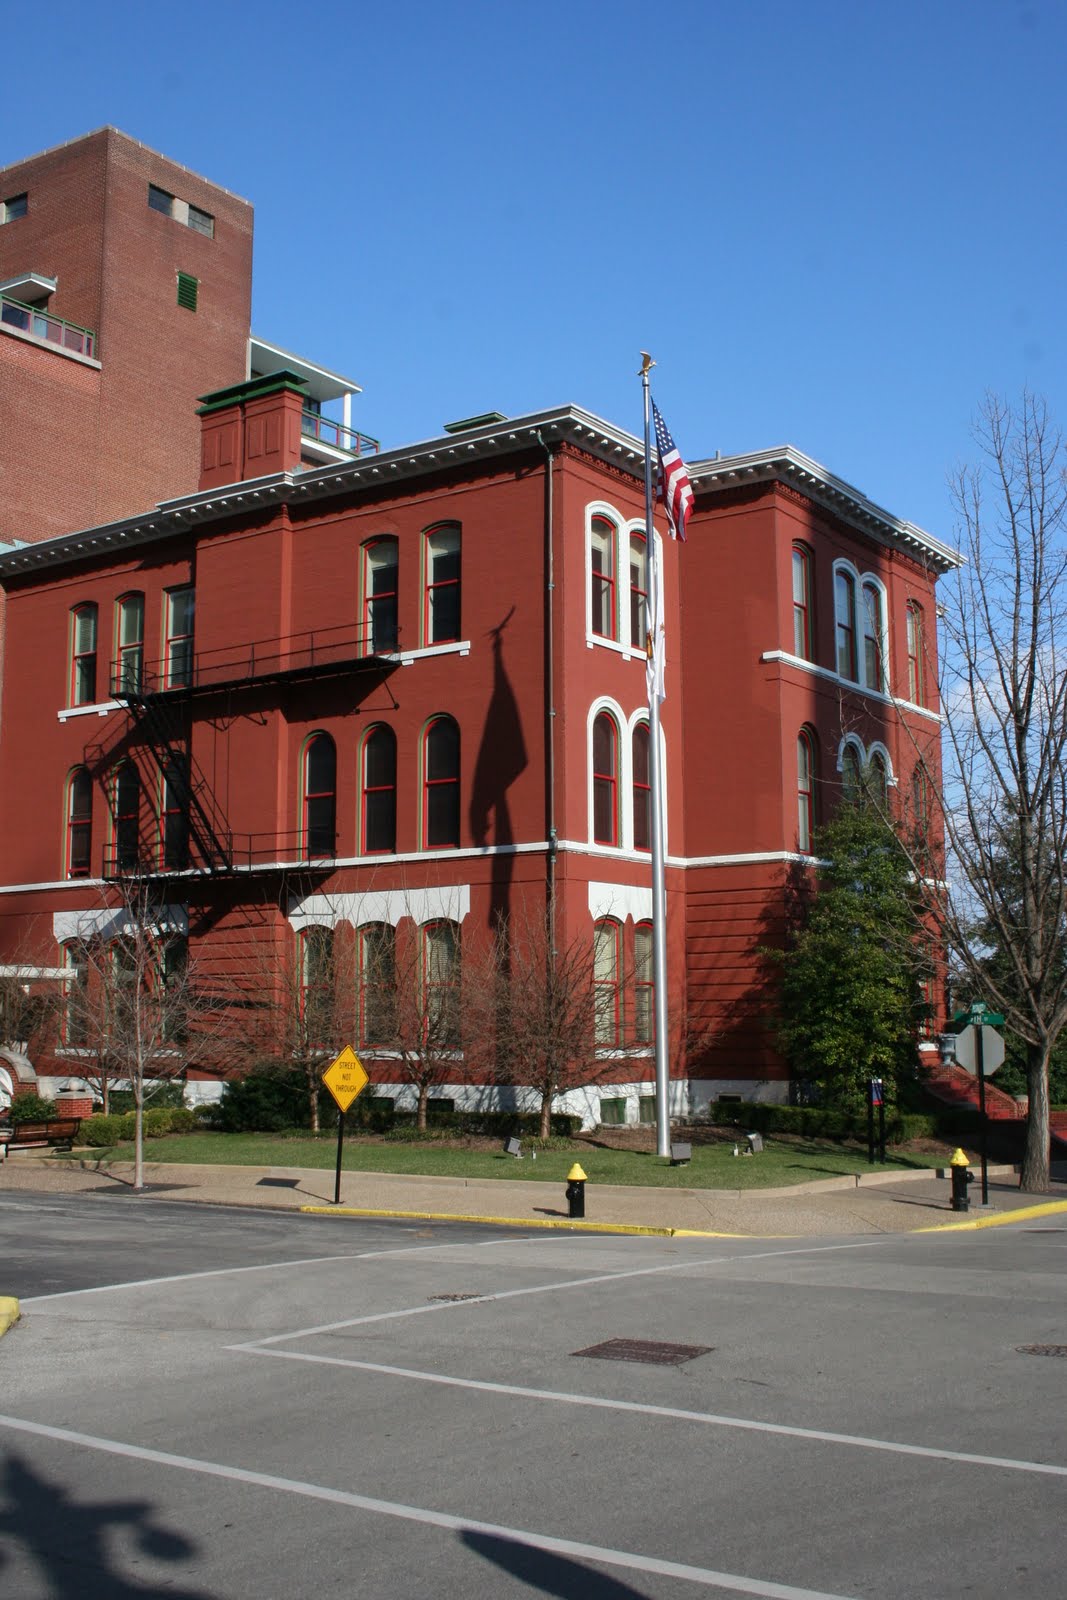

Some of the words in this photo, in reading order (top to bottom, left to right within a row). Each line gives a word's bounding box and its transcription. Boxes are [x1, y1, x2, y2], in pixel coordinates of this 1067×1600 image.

[339, 1061, 356, 1070] STREET
[342, 1073, 351, 1081] NOT
[335, 1084, 357, 1093] THROUGH
